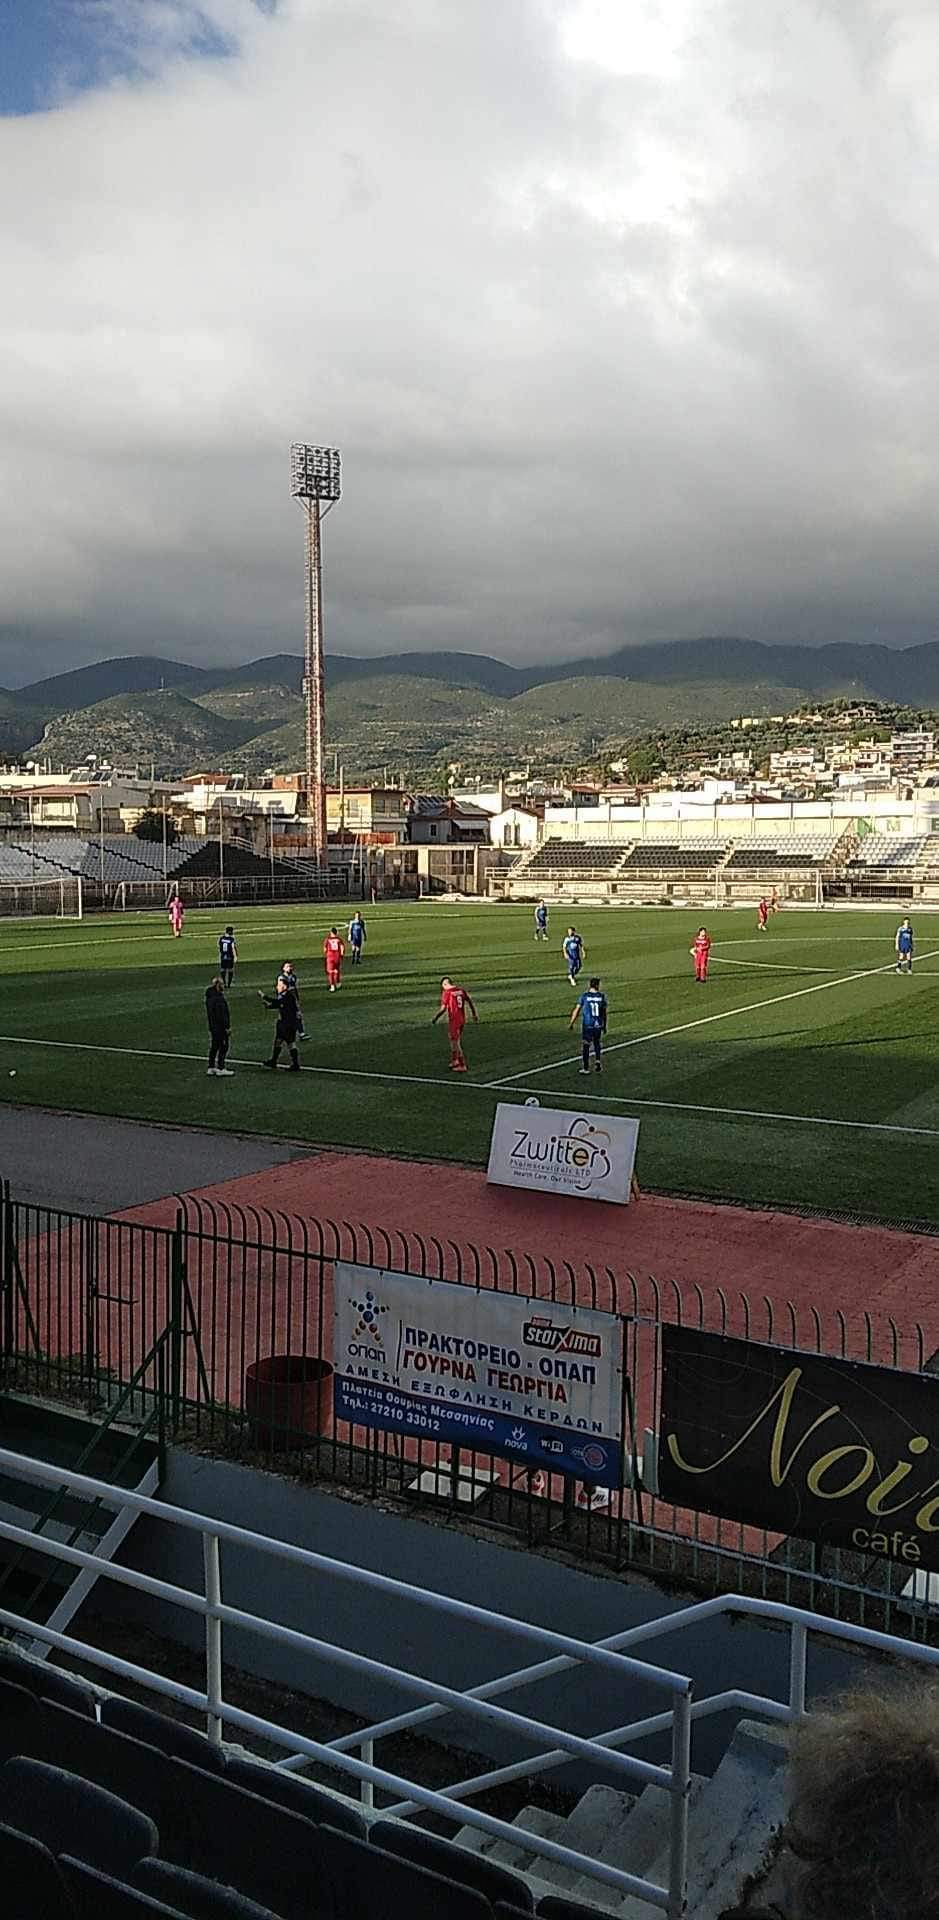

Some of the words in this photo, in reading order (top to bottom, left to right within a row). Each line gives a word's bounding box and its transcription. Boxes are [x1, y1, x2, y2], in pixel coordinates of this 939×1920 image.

[590, 1003, 599, 1016] 11
[510, 1130, 600, 1168] Zwitter
[405, 1327, 521, 1369] ΠΡΑΚΤΟΡΕΙΟ
[539, 1357, 596, 1385] ΟΠΑΠ
[403, 1350, 477, 1383] ΓΟΥΡΝΑ
[487, 1369, 567, 1403] ΓΕΩΡΓΙΑ
[342, 1382, 382, 1399] Πλατεία
[430, 1405, 494, 1431] Μεσσηνίας
[346, 1364, 400, 1386] ΑΜΕΣΗ
[411, 1380, 512, 1411] ΕΞΩΦΛΗΣΗ
[524, 1405, 602, 1432] ΚΕΡΔΩΝ
[371, 1400, 403, 1420] 27210
[406, 1411, 440, 1431] 33012
[504, 1439, 527, 1450] nova
[852, 1528, 921, 1562] café
